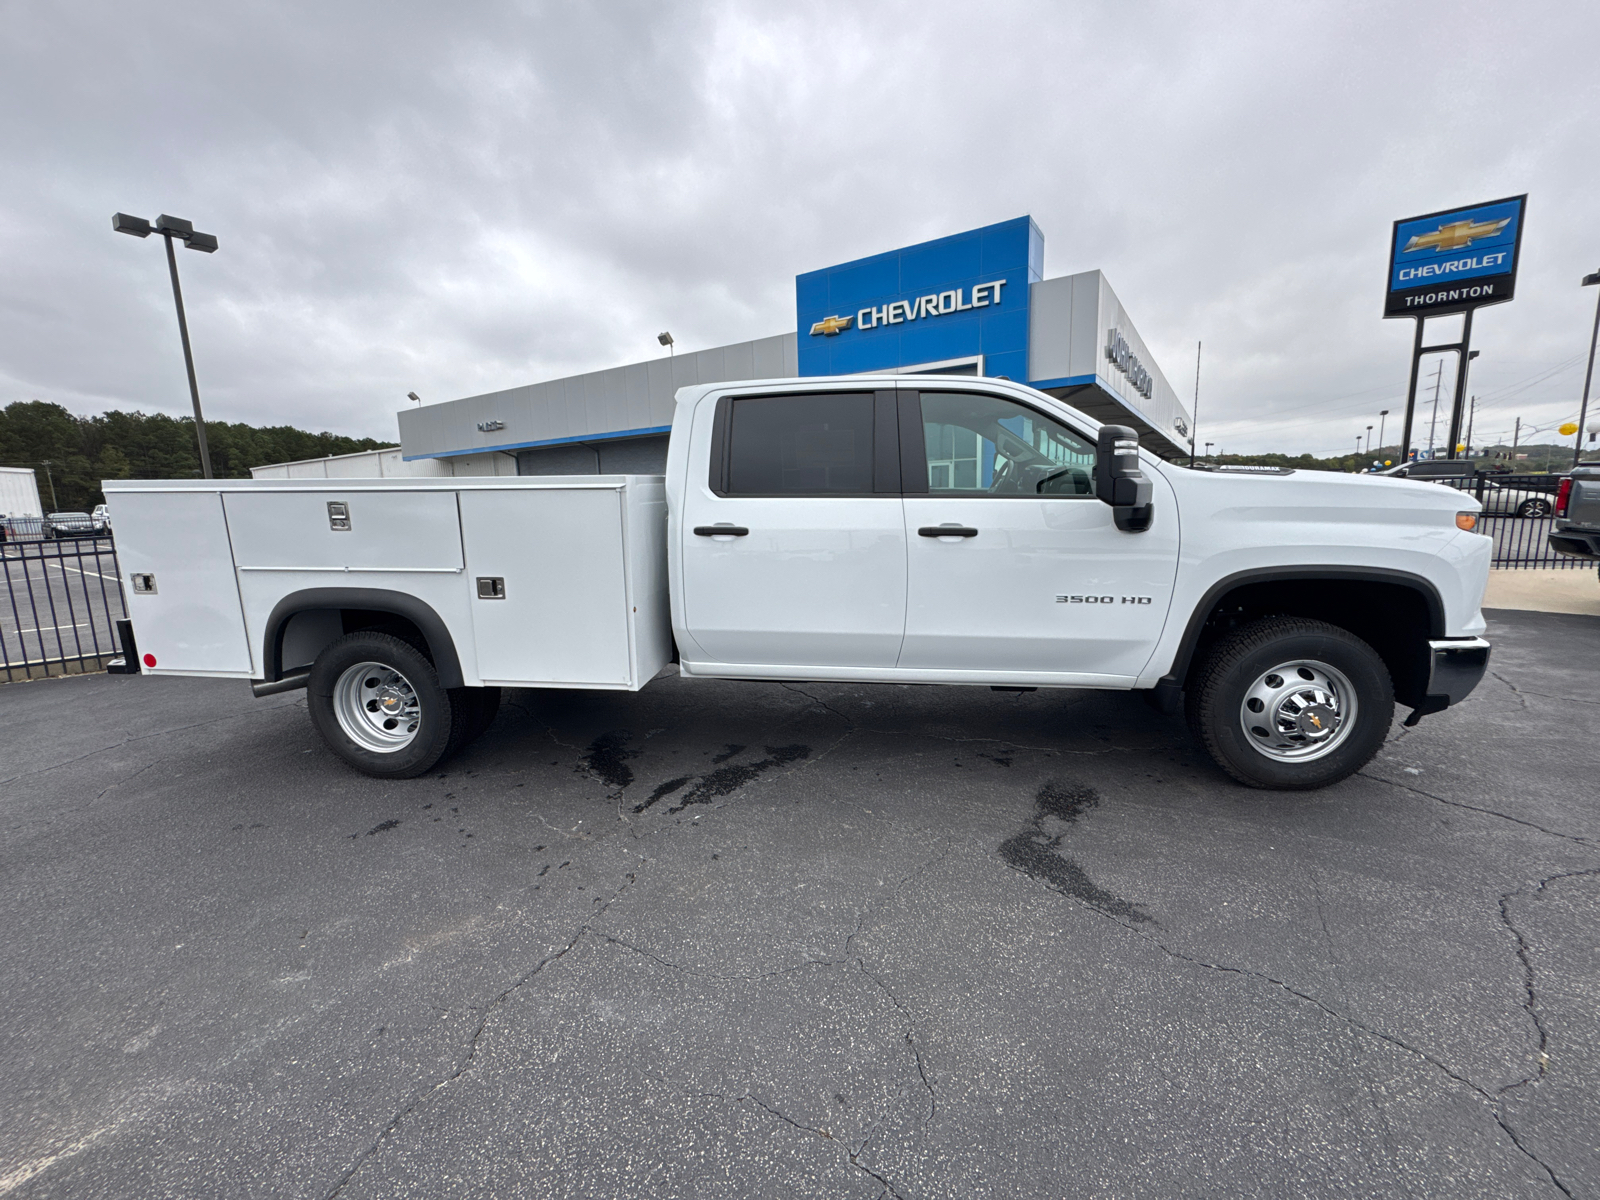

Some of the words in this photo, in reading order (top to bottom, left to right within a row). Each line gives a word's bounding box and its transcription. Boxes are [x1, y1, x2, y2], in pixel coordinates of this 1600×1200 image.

[1399, 252, 1507, 281] CHEVROLET
[857, 279, 1006, 331] CHEVROLET
[1405, 284, 1494, 307] THORNTON
[1055, 595, 1114, 604] 3500
[1121, 596, 1152, 605] HD
